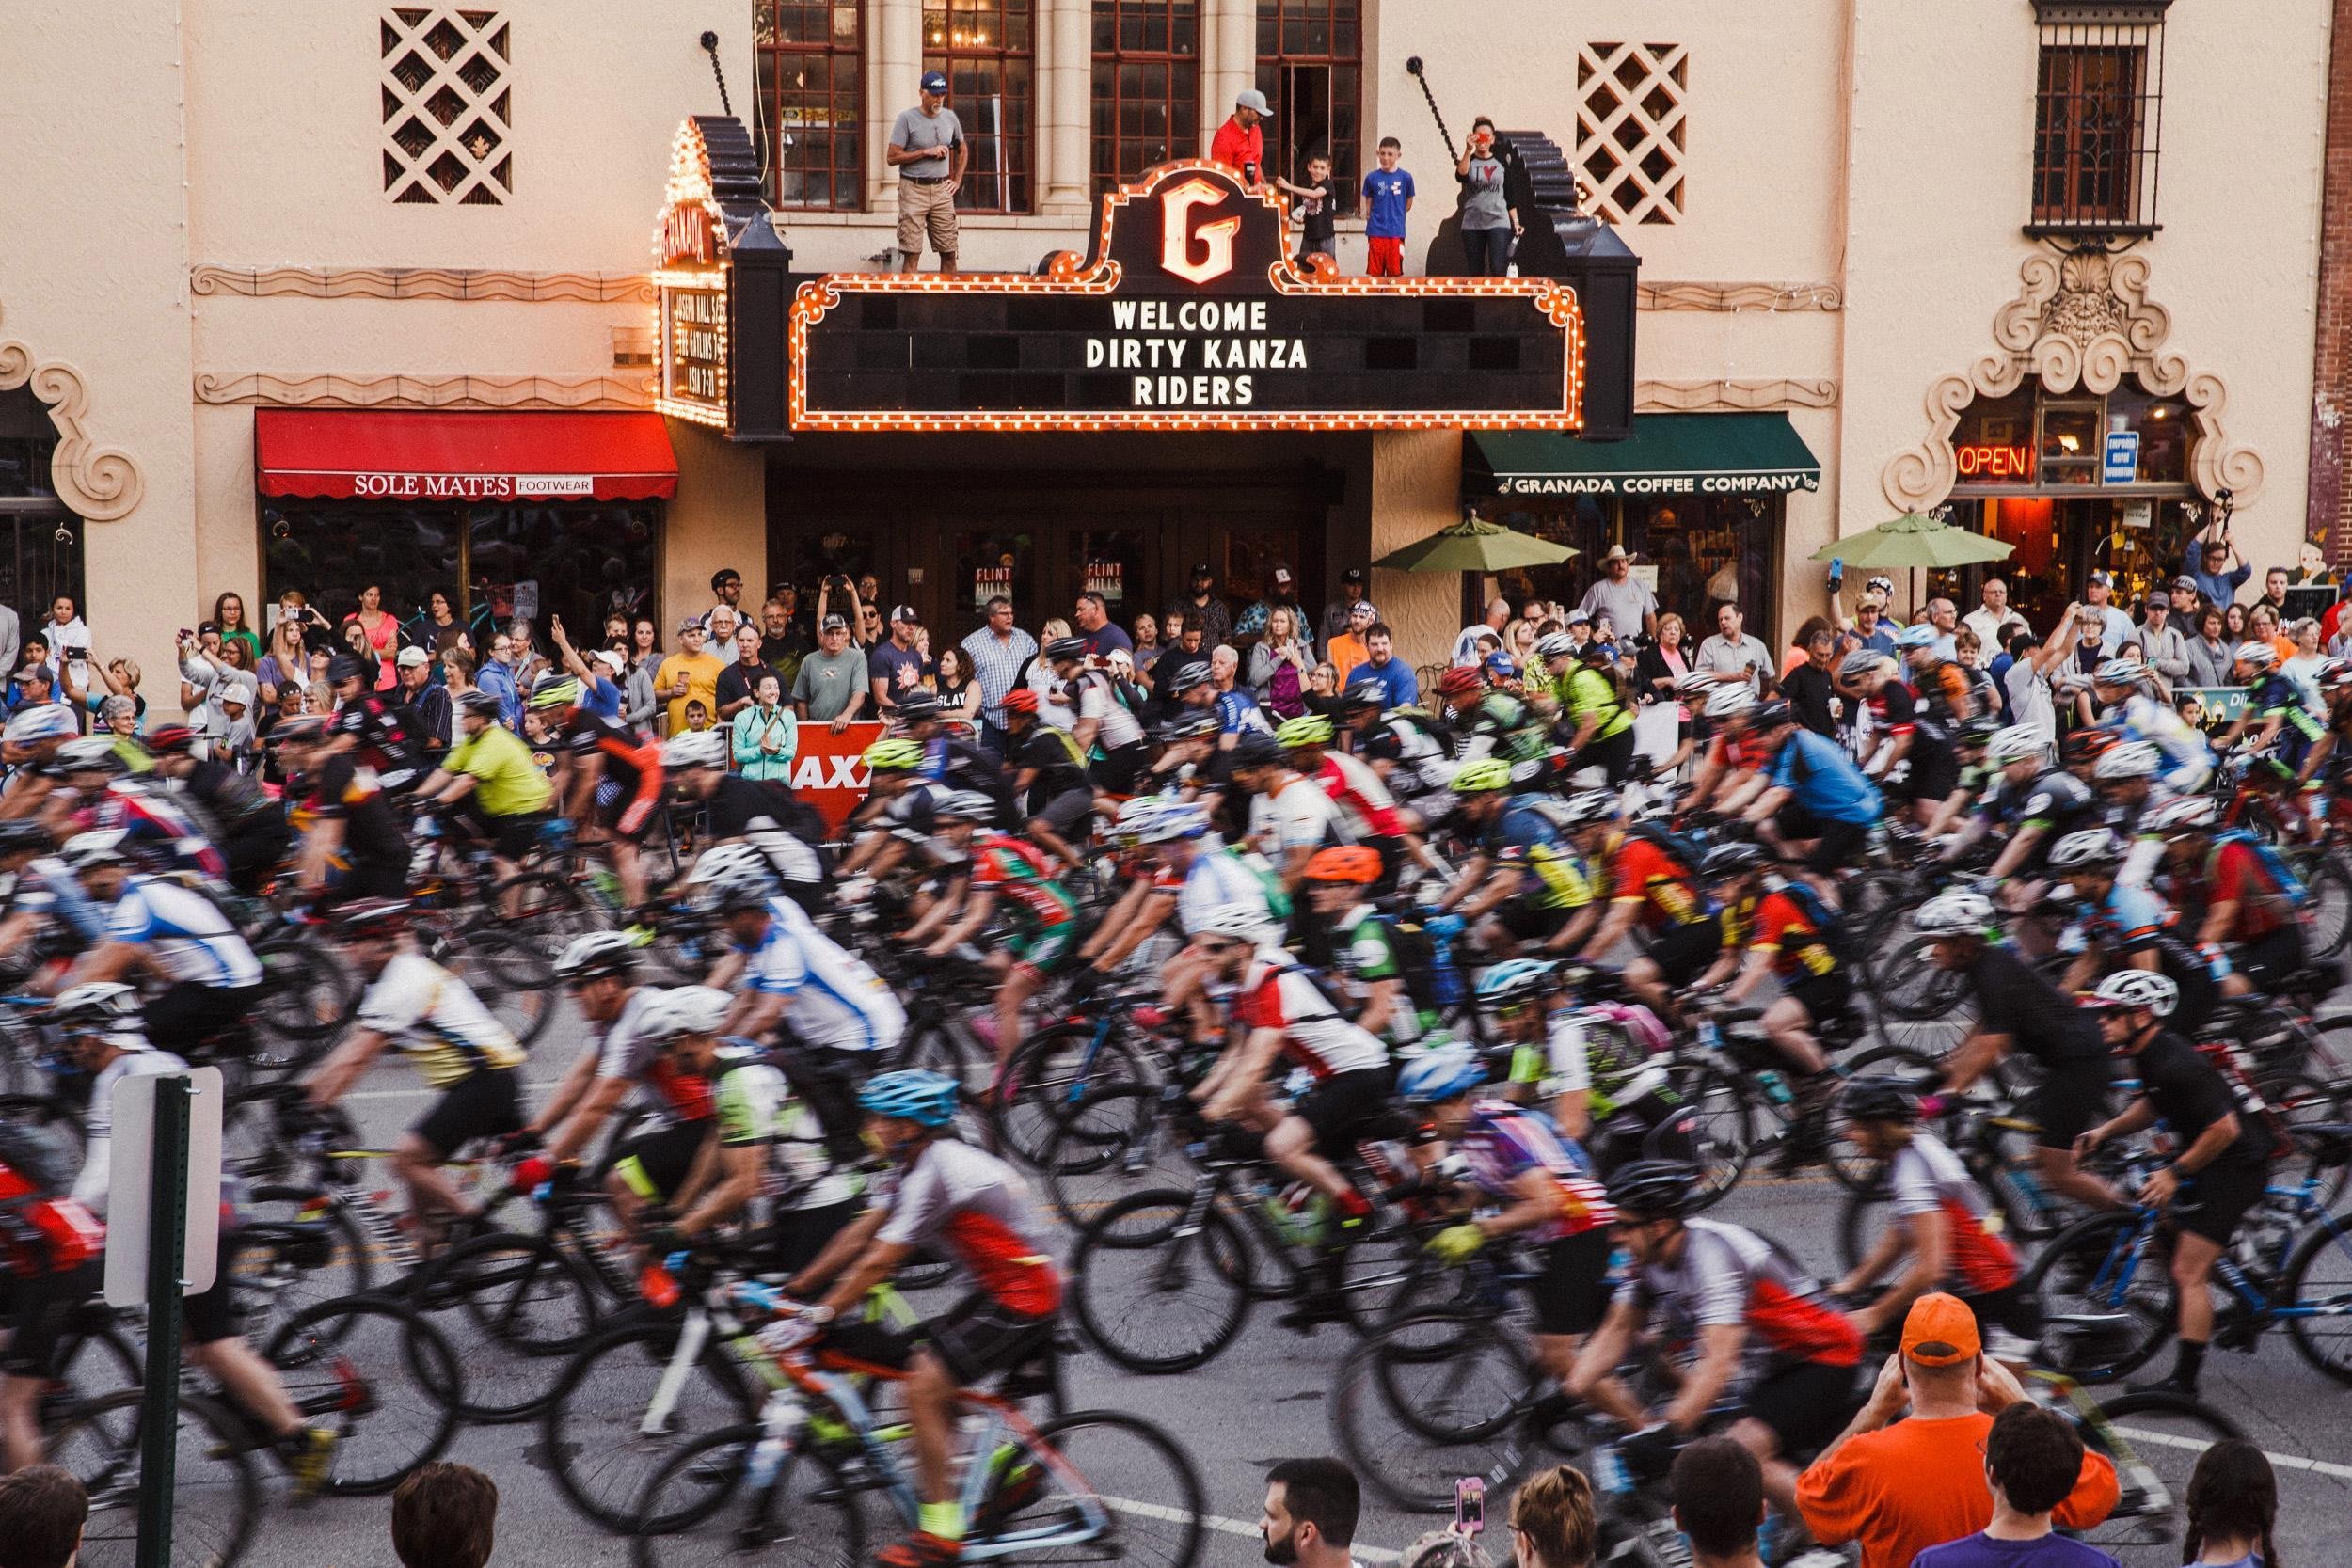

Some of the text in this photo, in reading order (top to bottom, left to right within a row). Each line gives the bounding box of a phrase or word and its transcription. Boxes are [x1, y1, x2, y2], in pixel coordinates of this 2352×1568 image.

[662, 206, 704, 264] GRANADA
[1160, 177, 1241, 284] G
[1112, 301, 1267, 332] WELCOME
[1086, 338, 1308, 370] DIRTY KANZA
[1134, 375, 1253, 406] RIDERS
[1958, 446, 2026, 477] OPEN
[355, 475, 510, 497] SOLE MATES
[518, 480, 590, 492] FOOTWEAR
[1515, 475, 1800, 494] GRANADA COFFEE COMPANY
[976, 567, 1010, 581] FLINT
[1087, 562, 1122, 577] FLINT
[976, 582, 1011, 596] HILLS
[1087, 578, 1122, 592] HILLS
[936, 692, 966, 707] SLAY
